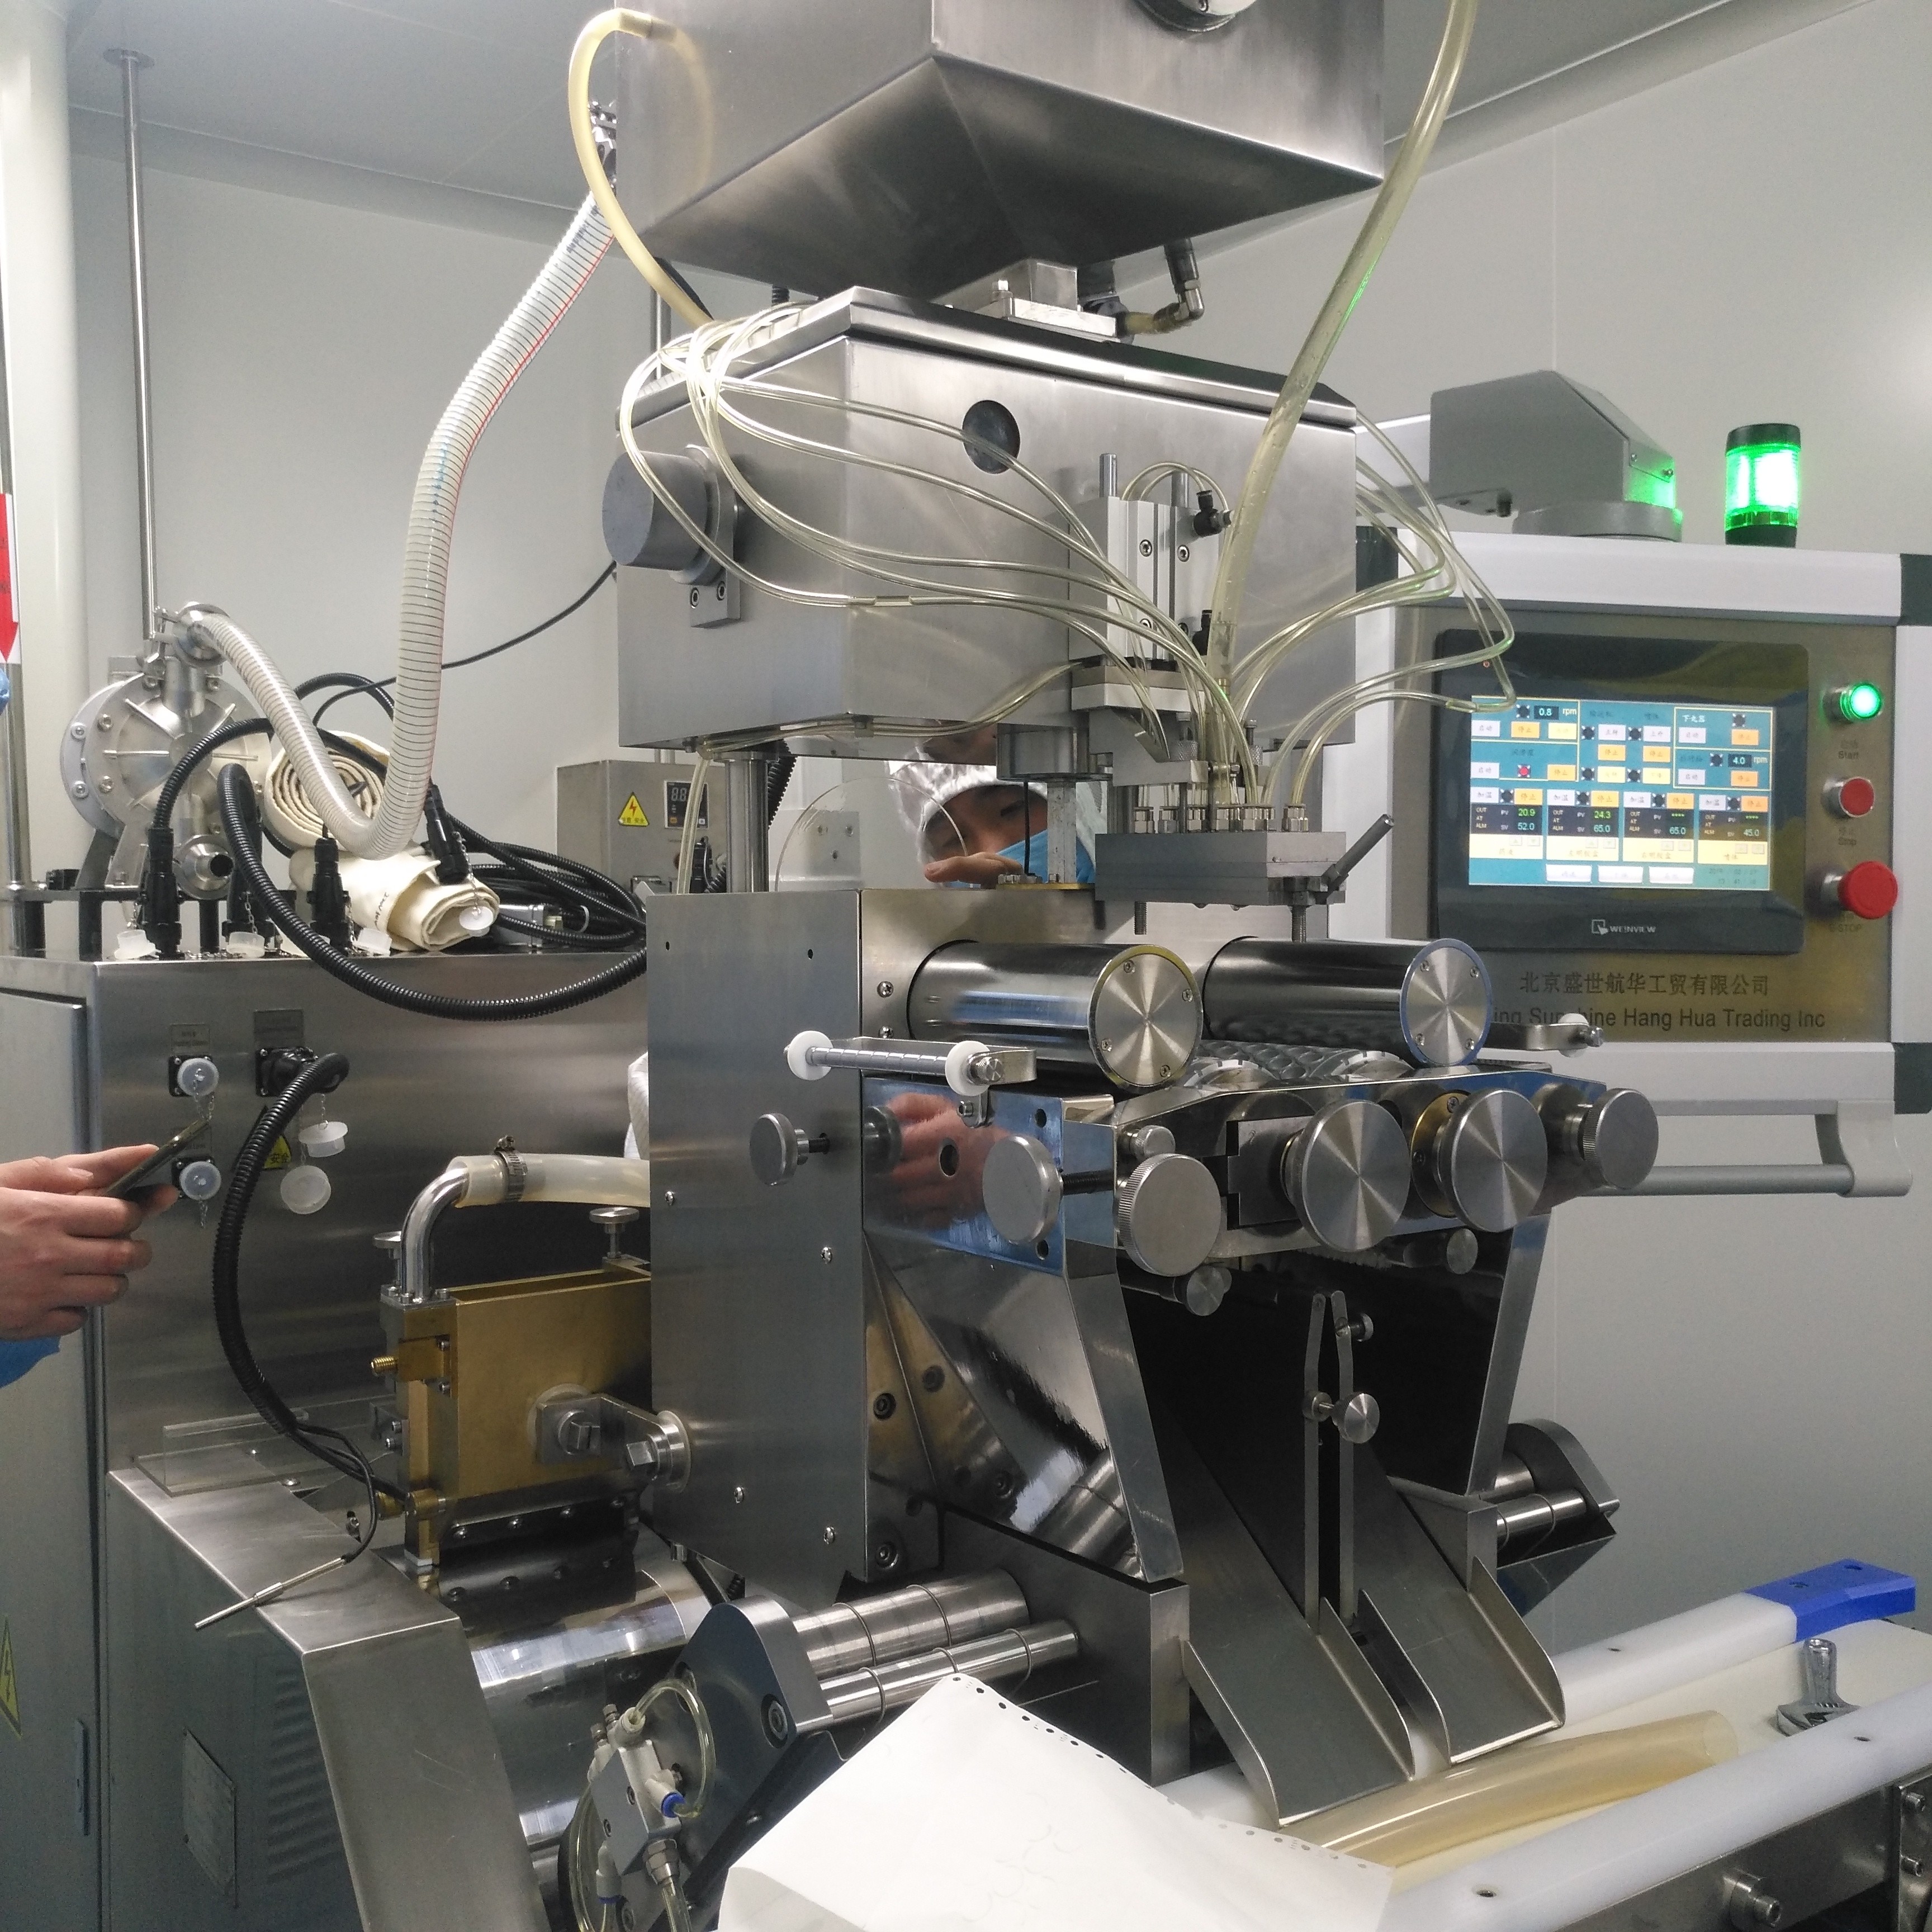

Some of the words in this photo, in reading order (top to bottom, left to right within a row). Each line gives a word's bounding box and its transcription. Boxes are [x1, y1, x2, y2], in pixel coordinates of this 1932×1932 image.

[1538, 708, 1552, 716] 0.8
[1562, 708, 1577, 716] rpm
[1520, 792, 1536, 801] 停止
[1597, 794, 1613, 803] 停止
[1518, 808, 1536, 817] 20.9
[1519, 971, 1768, 996] 北京盛世航华工贸有限公司
[1623, 1008, 1671, 1031] Hang
[1680, 1008, 1715, 1027] Hua
[1722, 1008, 1791, 1031] Trading
[1798, 1010, 1825, 1027] Inc
